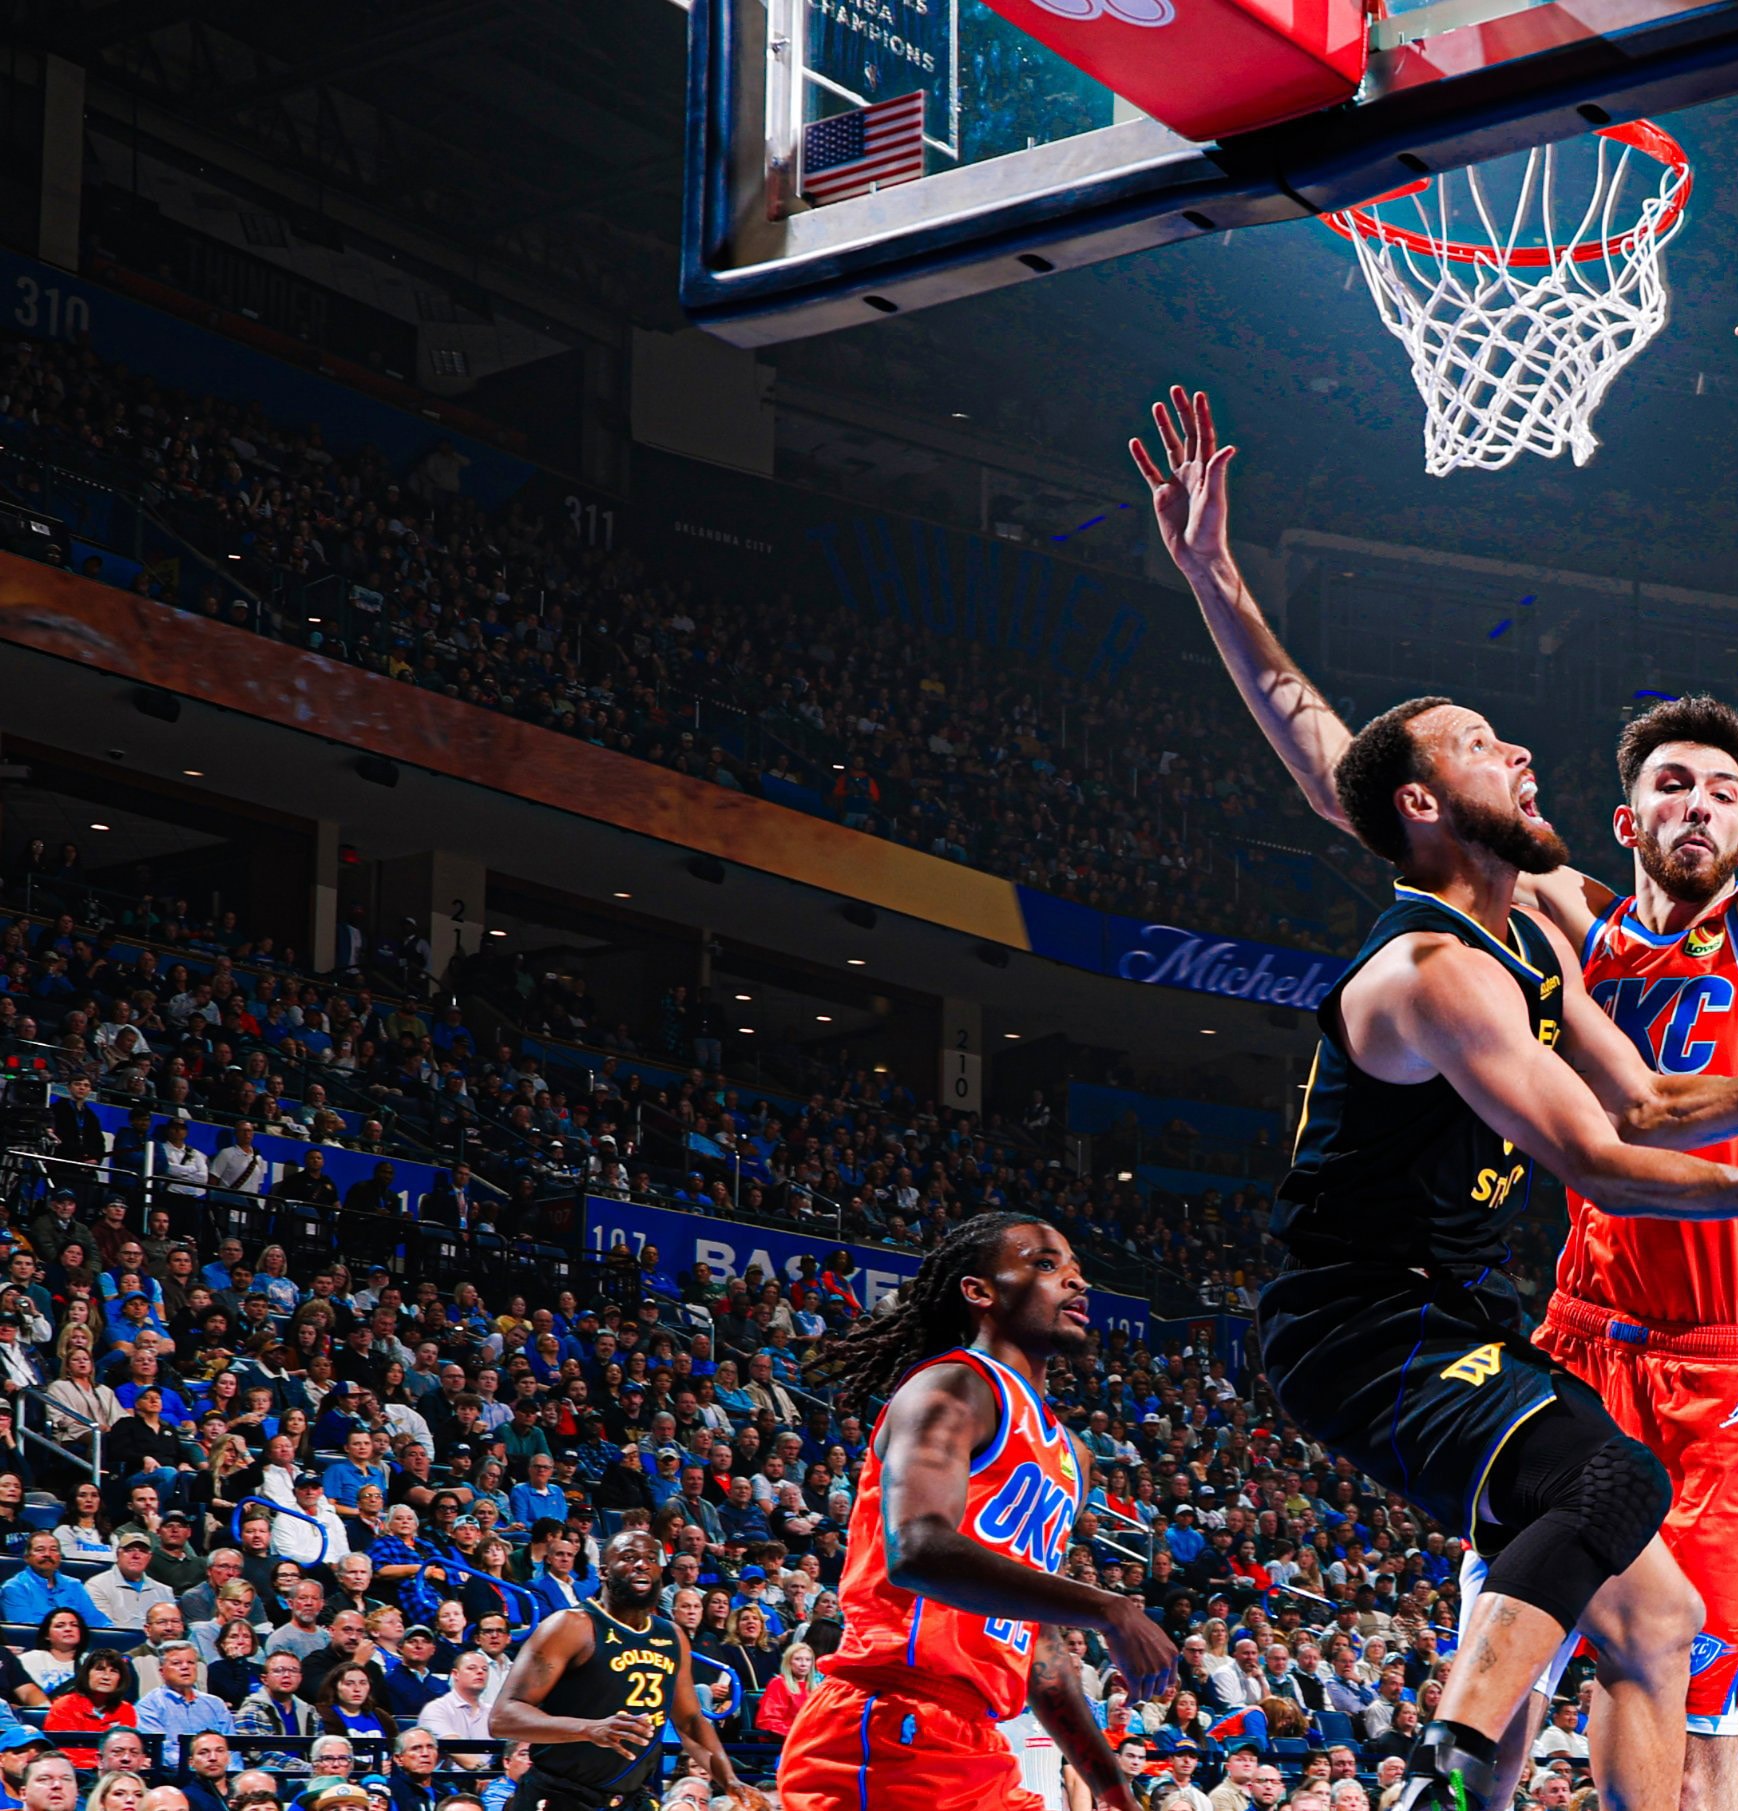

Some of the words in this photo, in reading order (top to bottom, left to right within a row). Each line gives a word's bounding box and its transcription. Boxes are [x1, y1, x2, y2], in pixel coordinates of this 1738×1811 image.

[14, 275, 91, 346] 310
[564, 495, 614, 550] 311
[745, 538, 774, 554] CITY
[805, 516, 1148, 683] THUNDER
[1118, 925, 1333, 1010] Michelo
[954, 1029, 969, 1098] 210
[695, 1238, 918, 1312] BASE
[974, 1461, 1074, 1576] OKC
[610, 1649, 676, 1675] GOLDEN
[625, 1671, 664, 1708] 23
